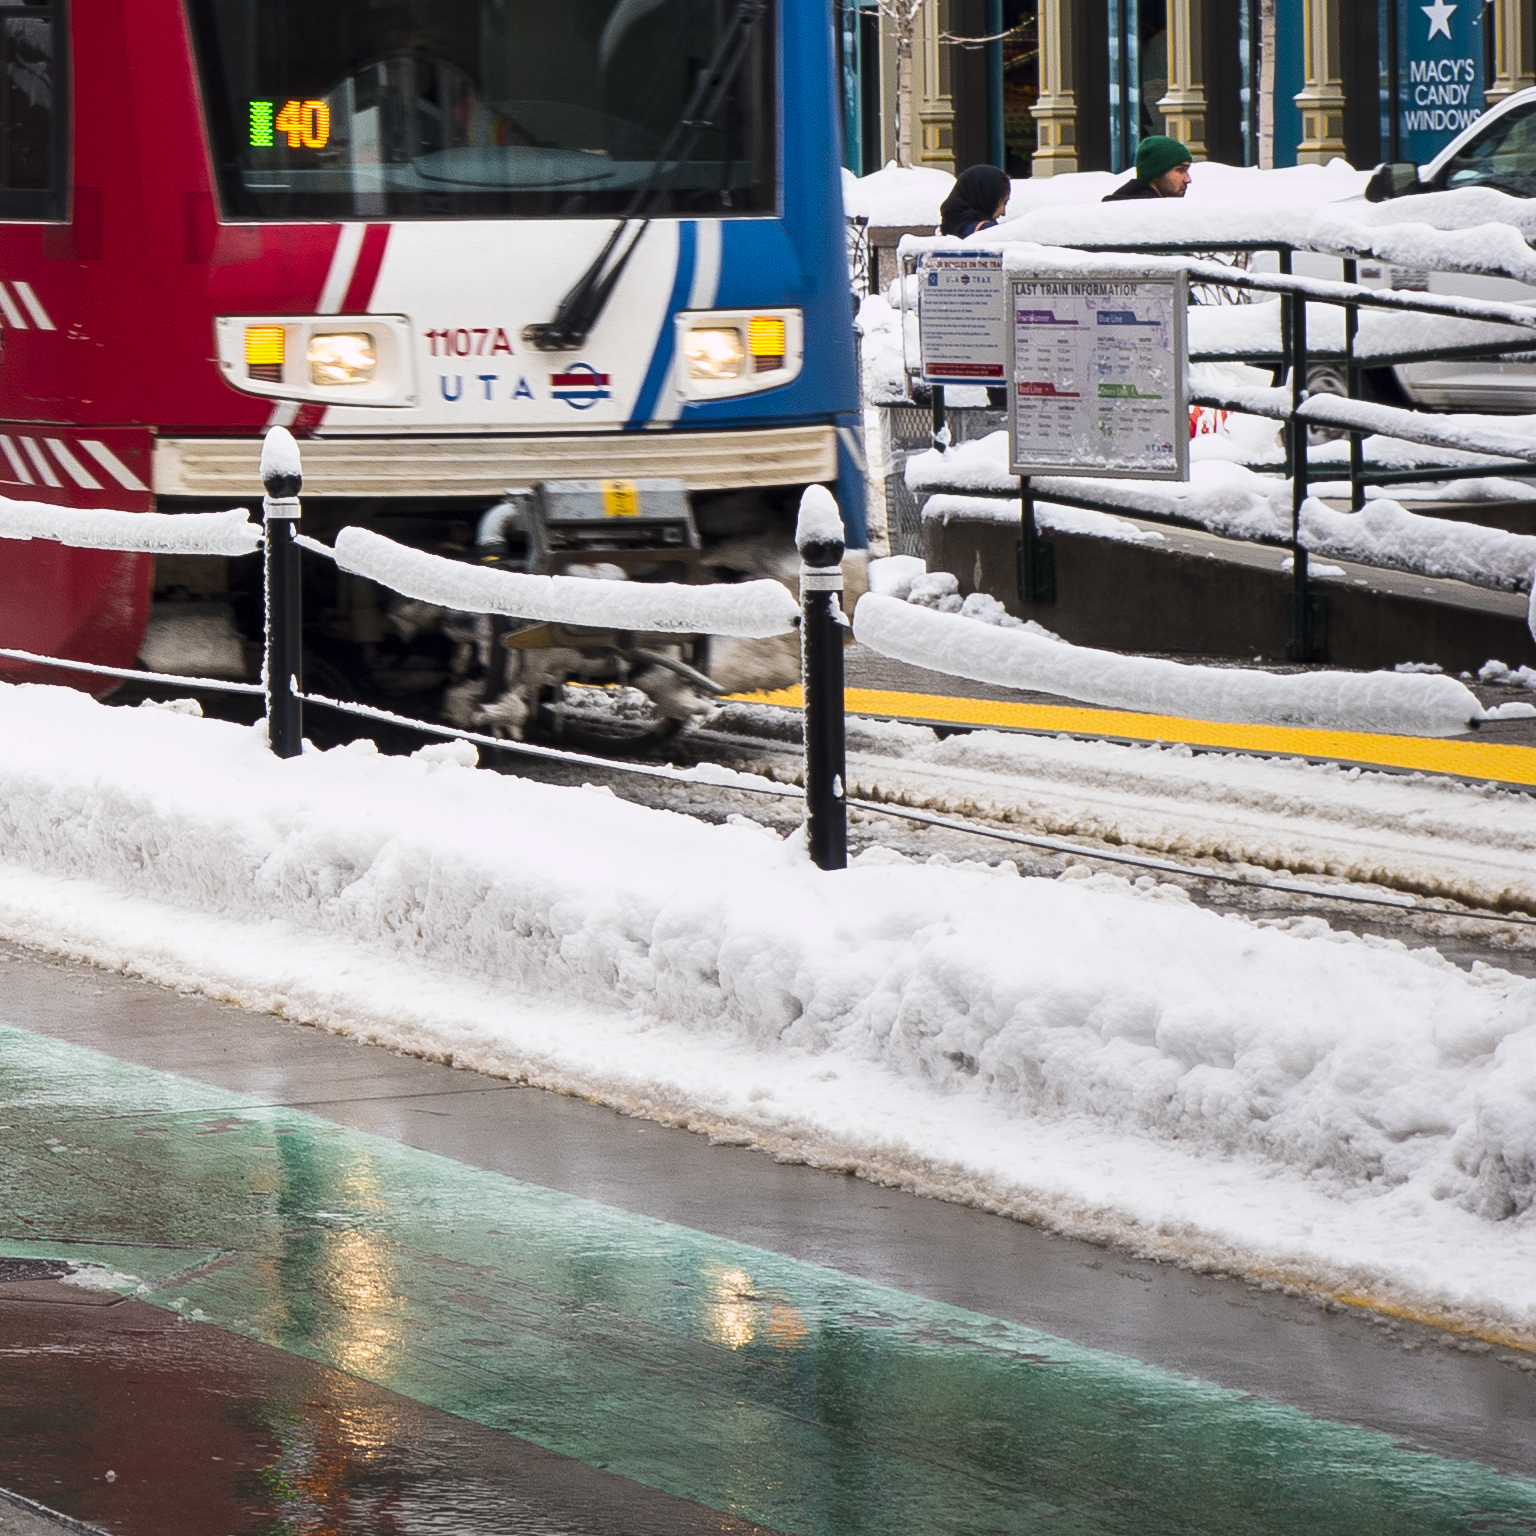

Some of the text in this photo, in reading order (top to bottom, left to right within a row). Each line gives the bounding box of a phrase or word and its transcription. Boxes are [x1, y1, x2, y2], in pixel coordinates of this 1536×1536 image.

[1410, 59, 1475, 83] MACY'S
[1415, 84, 1470, 106] CANDY
[275, 100, 330, 149] 40
[1405, 109, 1482, 131] WINDOWS
[1015, 283, 1038, 296] LAST
[1040, 283, 1069, 296] TRAIN
[1070, 283, 1138, 296] INFORMATION
[424, 327, 514, 358] 1107A
[440, 375, 534, 402] UTA
